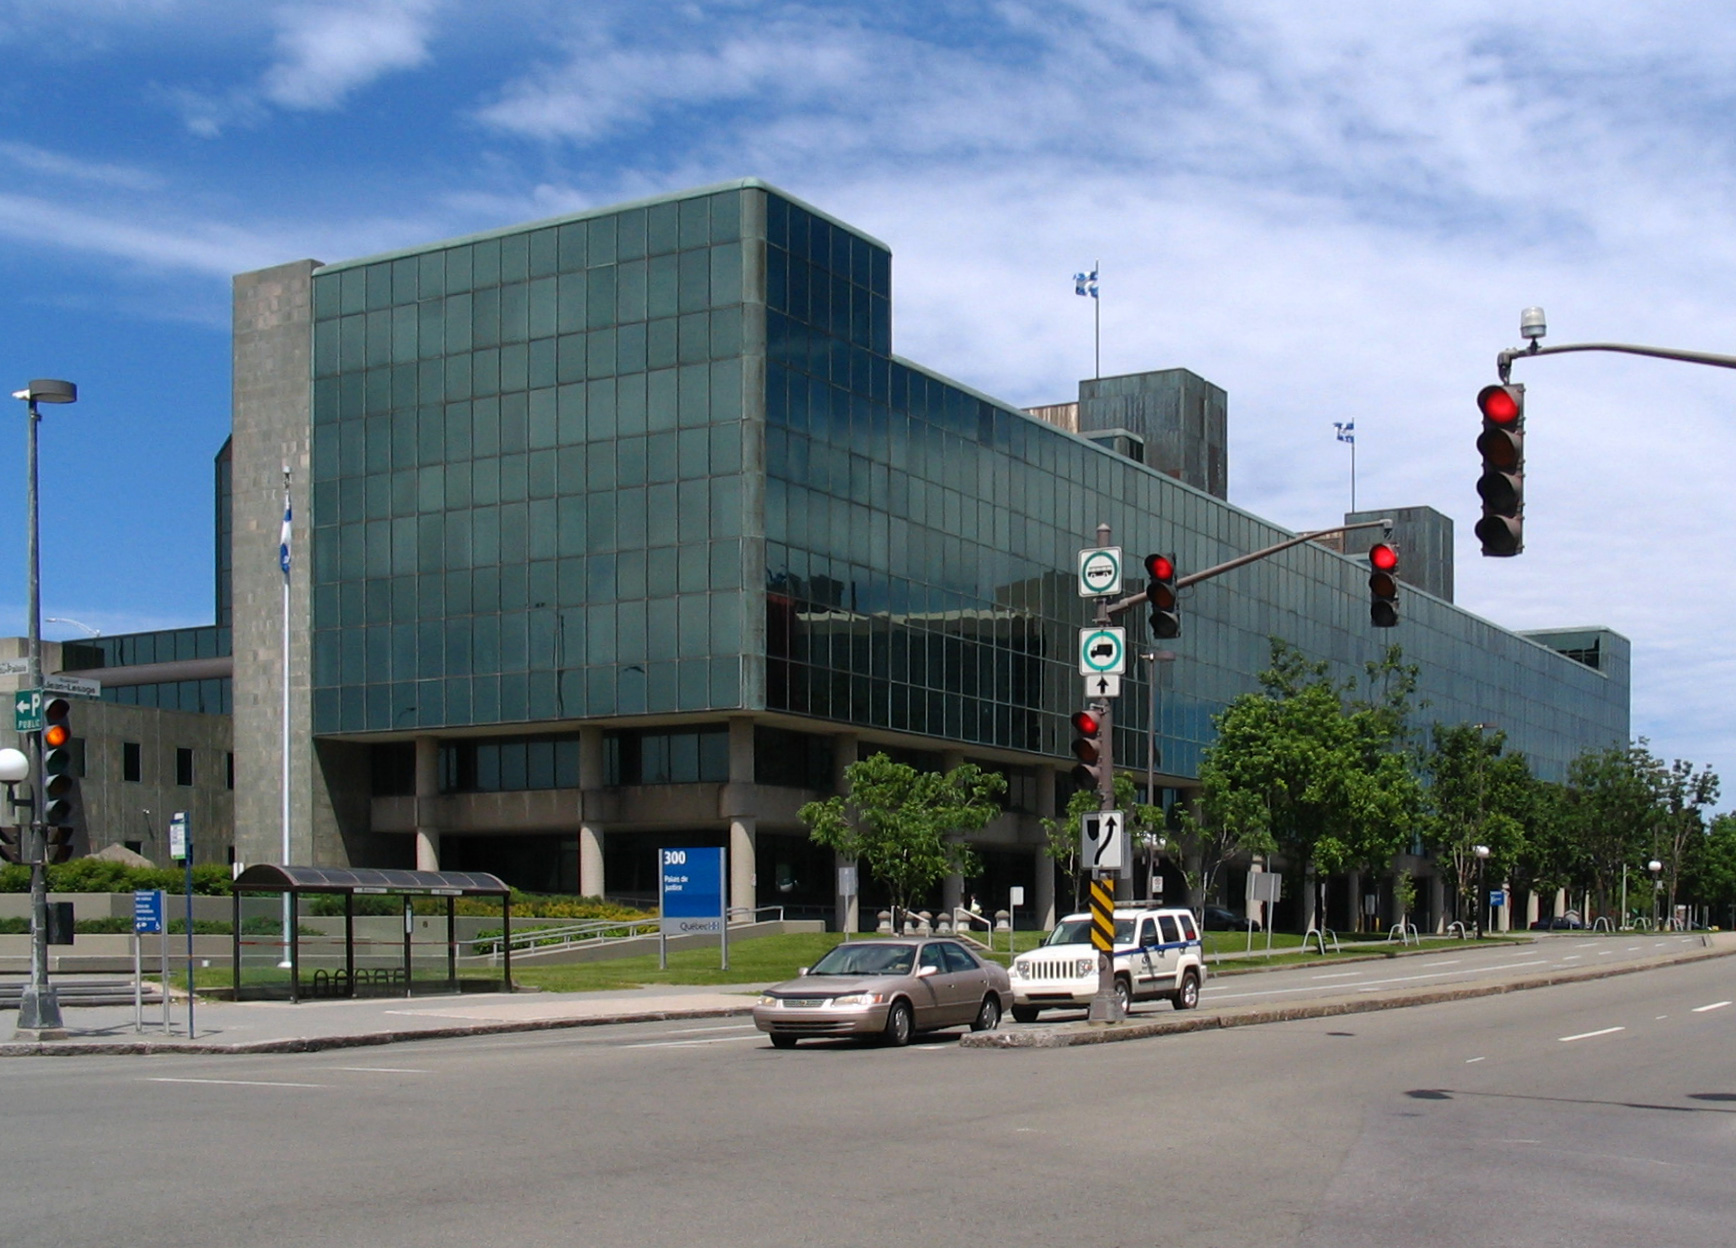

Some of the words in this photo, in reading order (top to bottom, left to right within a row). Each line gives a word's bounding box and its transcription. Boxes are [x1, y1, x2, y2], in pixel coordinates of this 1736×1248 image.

[45, 681, 96, 695] Jean-Lesage
[32, 693, 40, 717] P
[18, 719, 40, 729] PUBLIC
[664, 851, 686, 865] 300
[680, 921, 708, 931] Québec
